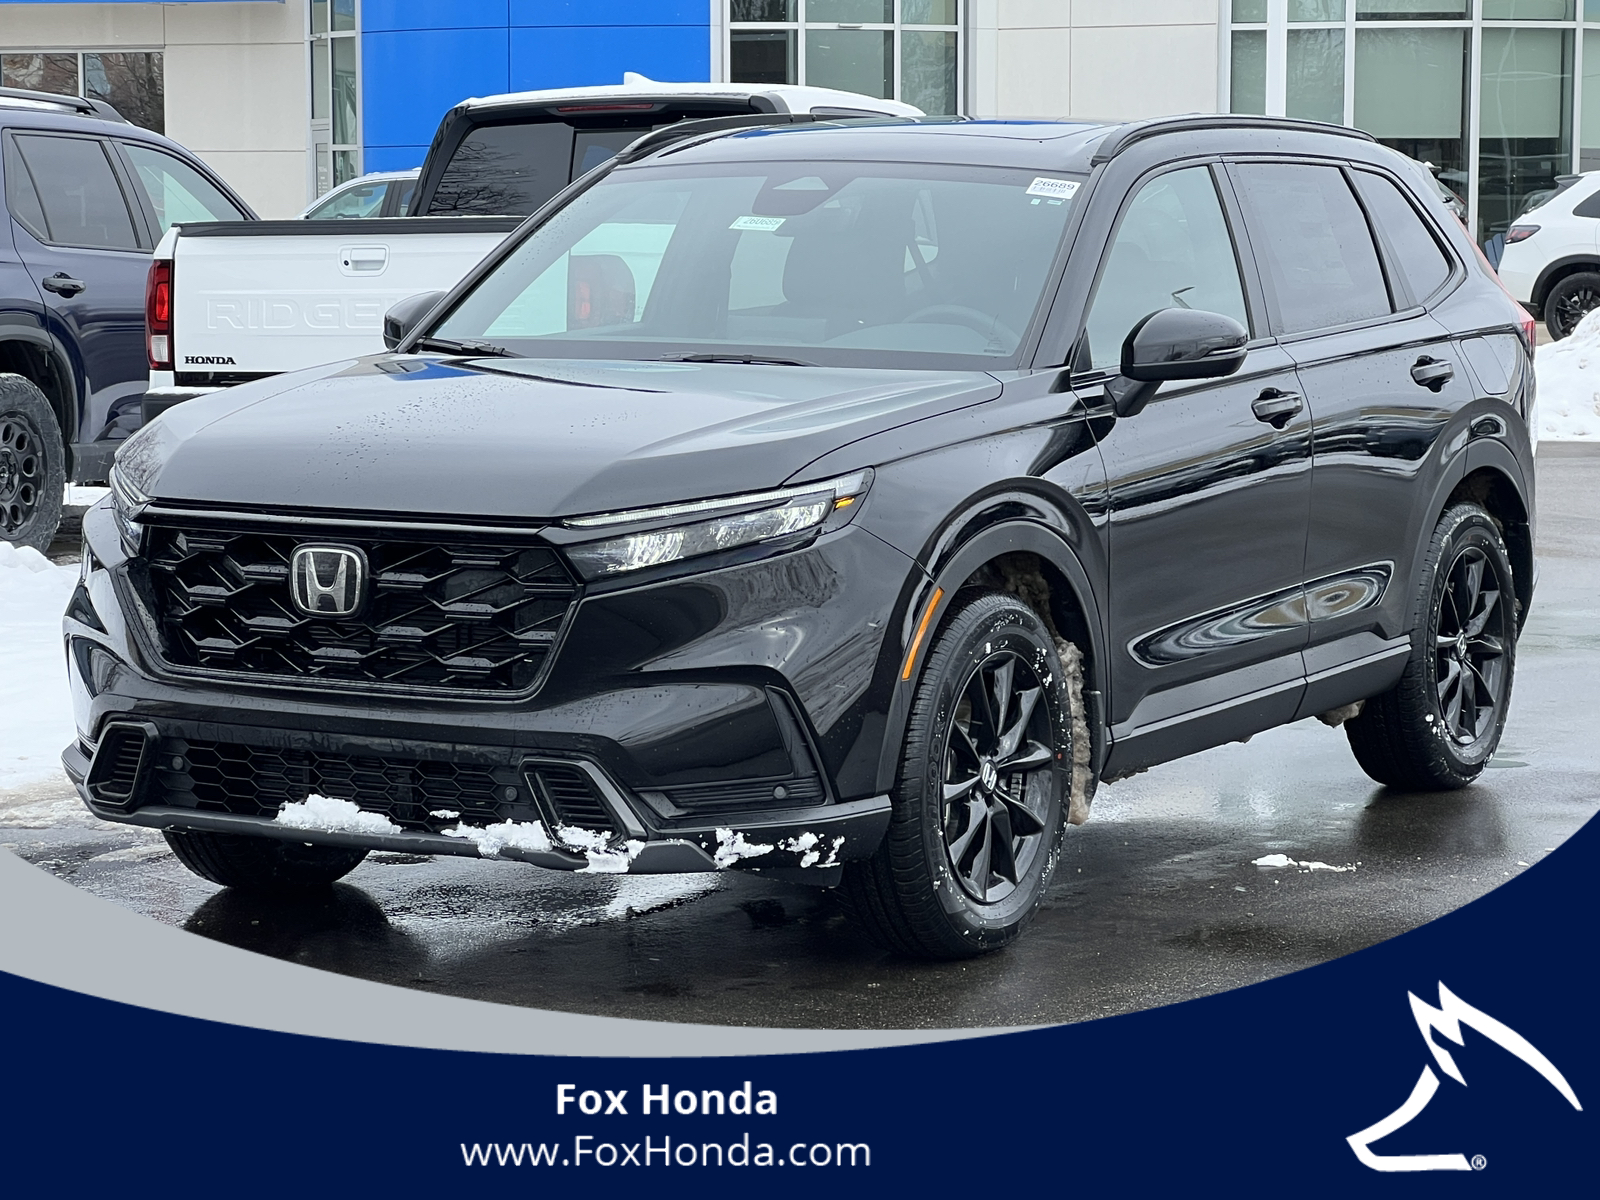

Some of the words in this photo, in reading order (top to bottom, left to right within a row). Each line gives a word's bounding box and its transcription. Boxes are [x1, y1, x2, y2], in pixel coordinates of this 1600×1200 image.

[1034, 179, 1075, 190] 26689
[207, 298, 397, 329] RIDGE
[184, 355, 237, 365] HONDA
